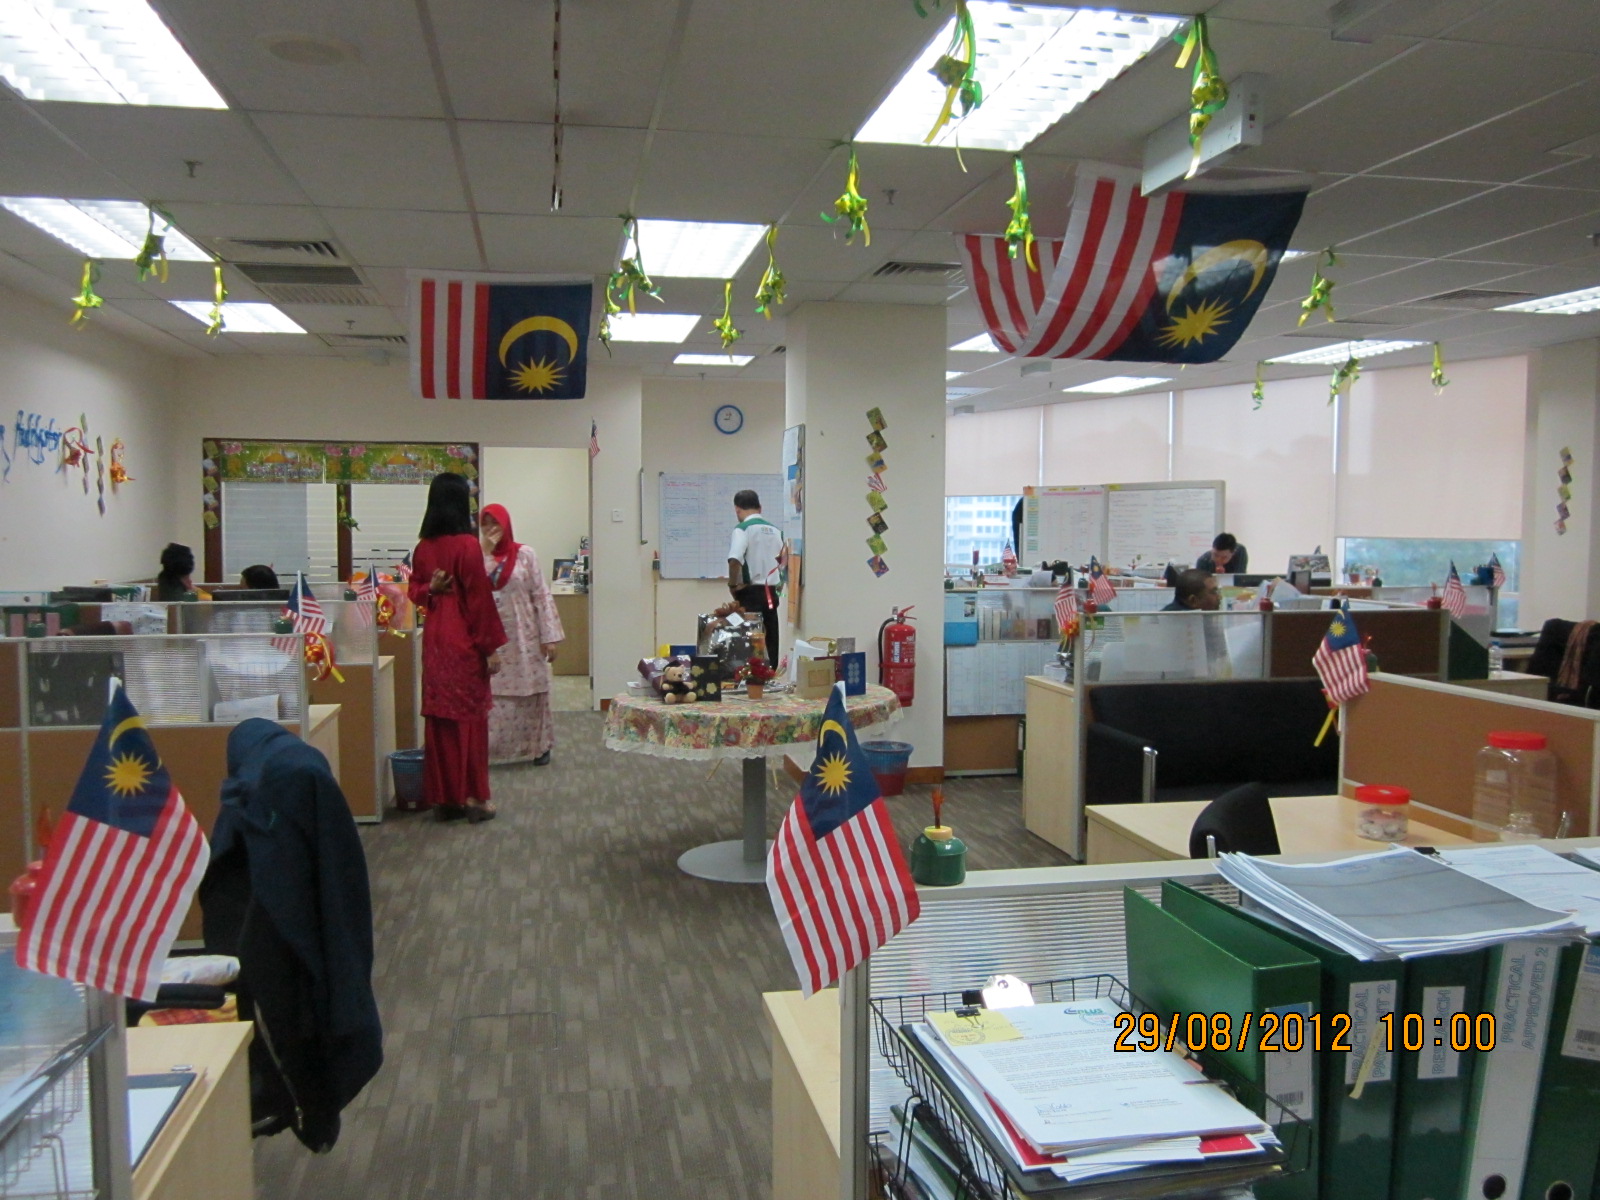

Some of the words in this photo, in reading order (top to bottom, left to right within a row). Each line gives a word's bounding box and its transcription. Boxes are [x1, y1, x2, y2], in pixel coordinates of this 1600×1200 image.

[1378, 983, 1391, 994] 2
[1501, 954, 1526, 1043] PRACTICAL
[1521, 960, 1547, 1050] APPROVED
[1534, 946, 1549, 958] 2
[1350, 988, 1369, 1081] PRACTICAL
[1372, 998, 1390, 1078] PAYNT
